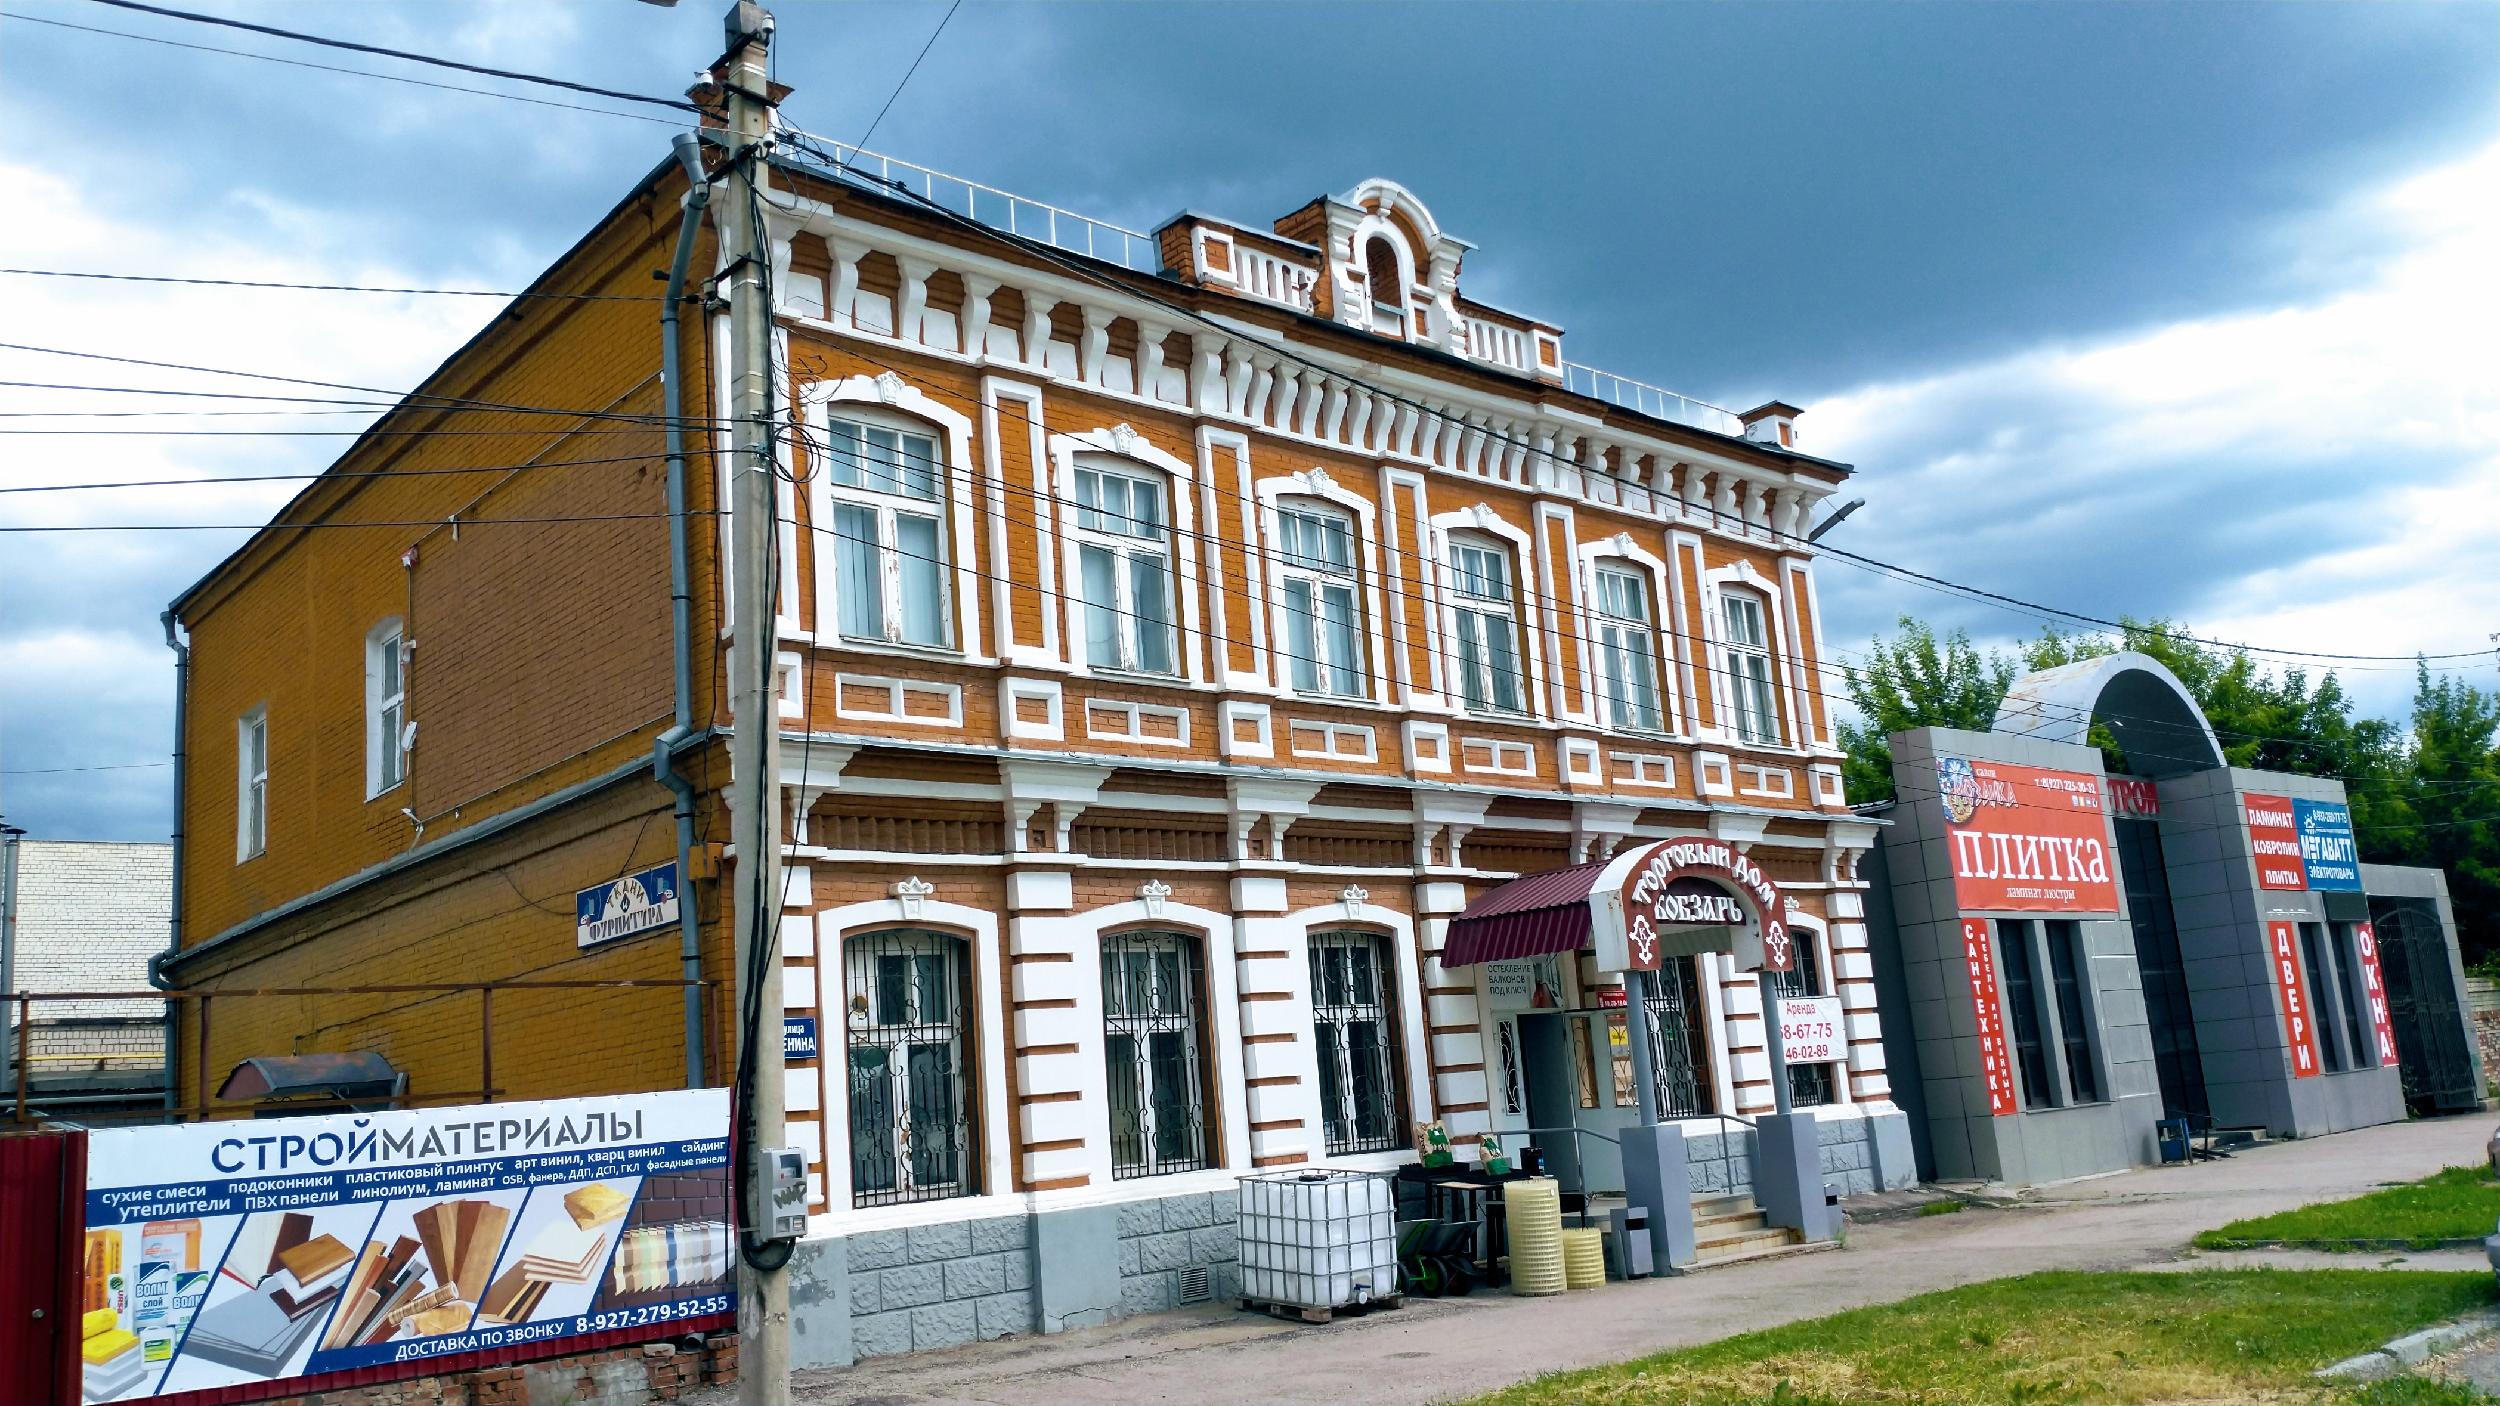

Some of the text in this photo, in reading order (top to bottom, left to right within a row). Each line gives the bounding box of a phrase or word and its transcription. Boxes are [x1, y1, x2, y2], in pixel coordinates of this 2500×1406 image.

[2247, 808, 2293, 829] ЛАМИНАТ
[2252, 839, 2301, 857] КОВРОЛИН
[2300, 835, 2353, 863] МЕГАВАТТ
[2264, 869, 2301, 885] ПЛИТКА
[2308, 866, 2356, 880] ЭЛЕКТРОТОВАРЫ
[607, 879, 645, 908] ТКАНИ
[2043, 888, 2076, 904] люстры
[1655, 894, 1743, 922] КОБЗАРЬ
[1487, 963, 1532, 974] ОСТЕКЛЕНИЕ
[1488, 974, 1526, 984] БАЛКОНОВ
[2276, 927, 2312, 1070] ДВЕРИ
[2359, 930, 2392, 1058] ОКНА
[1786, 1002, 1816, 1015] Аренда
[1964, 924, 2002, 1110] САНТЕХНИКА
[784, 1036, 816, 1052] ЕНИНА
[1785, 1044, 1829, 1060] 46-02-89
[211, 1109, 643, 1174] СТРОЙМАТЕРИАЛЫ
[102, 1140, 727, 1204] сухие смеси подоконники пластиковый плинтус арт винил, кварц винил сайдинг
[119, 1197, 232, 1222] утеплители
[244, 1195, 279, 1211] ПВХ
[279, 1190, 340, 1206] панели
[351, 1181, 431, 1200] линолиум,
[434, 1177, 495, 1193] ламинат
[528, 1170, 567, 1186] фанера,
[620, 1162, 640, 1174] ГКЛ
[646, 1157, 695, 1173] фасадные
[695, 1154, 728, 1168] панели
[136, 1281, 168, 1299] ВОЛМ
[395, 1295, 728, 1362] ДОСТАВКА ПО ЗВОНКУ 8-927-279-52-55
